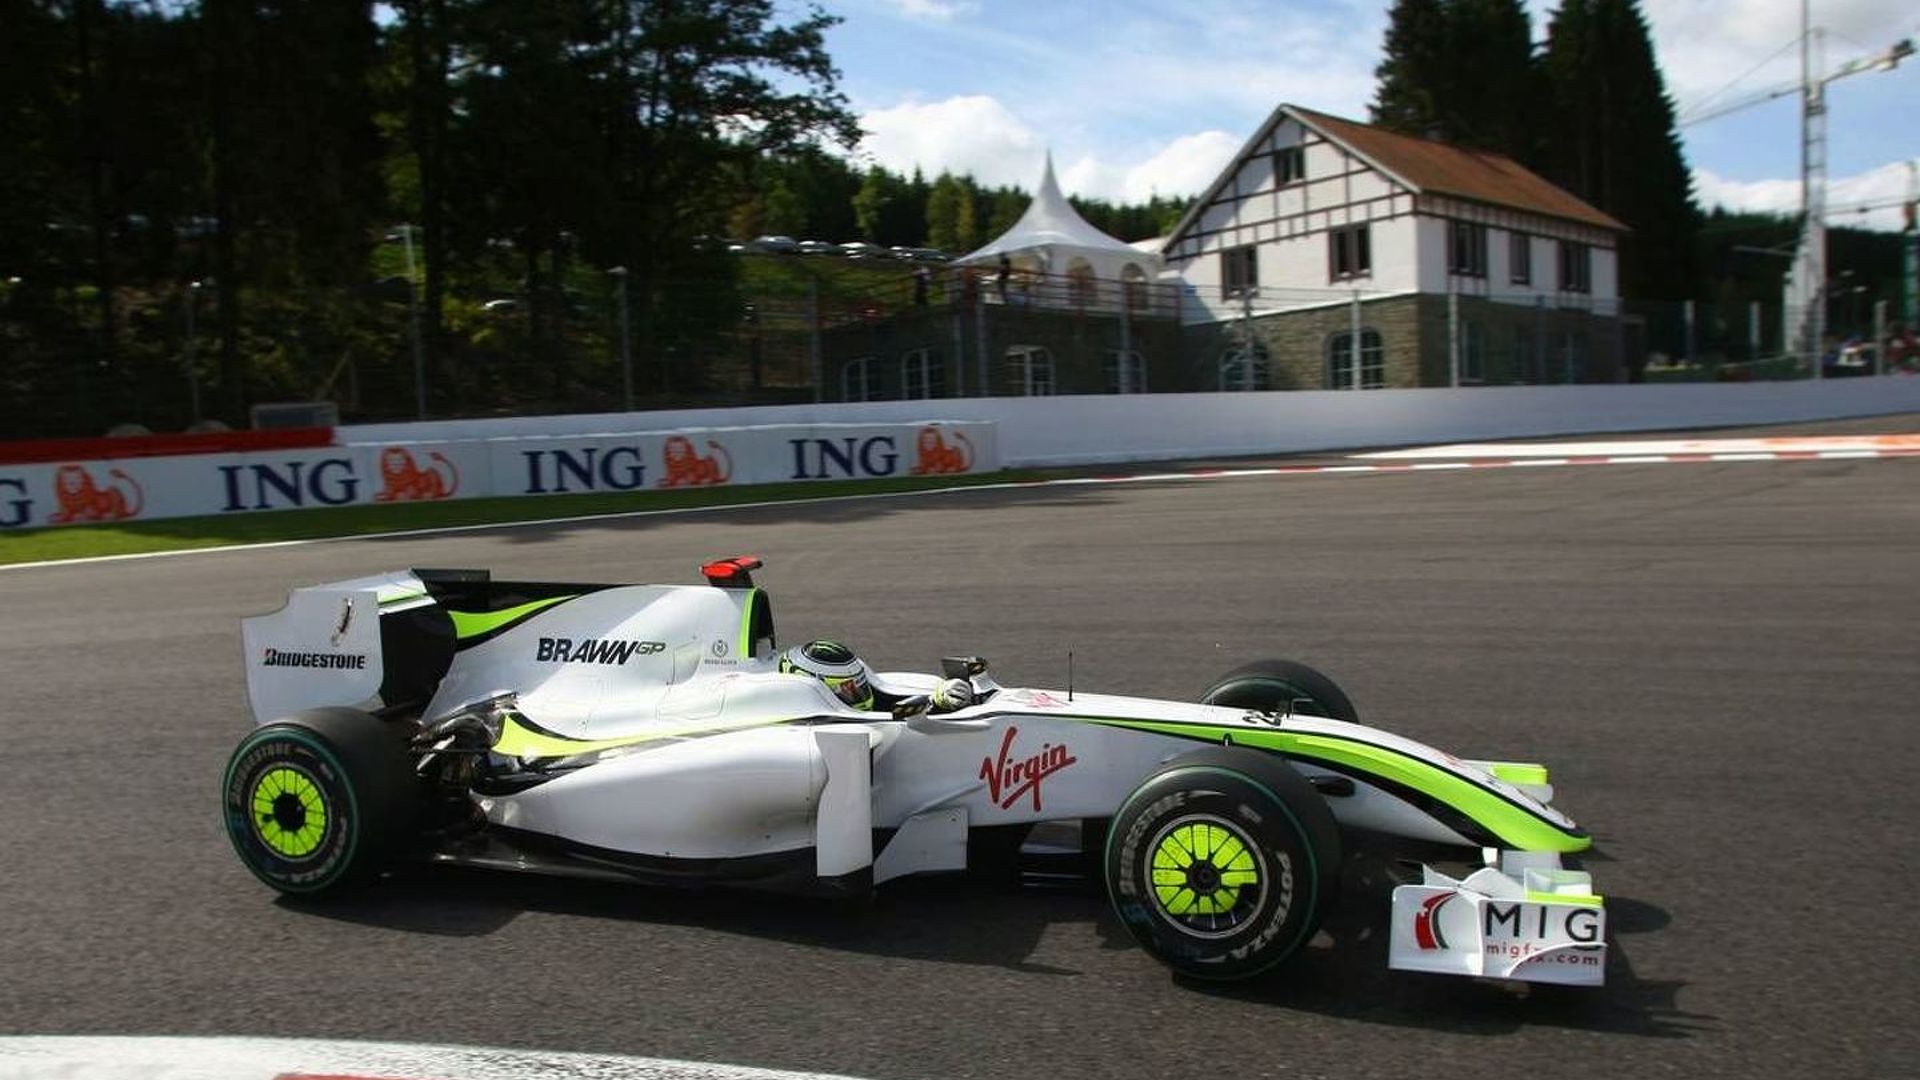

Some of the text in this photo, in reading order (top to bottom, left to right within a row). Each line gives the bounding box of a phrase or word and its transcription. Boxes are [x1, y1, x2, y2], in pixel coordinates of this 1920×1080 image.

[522, 446, 646, 493] ING
[789, 436, 898, 479] ING
[219, 459, 359, 511] ING
[263, 648, 366, 669] BRIDGESTONE
[536, 637, 639, 665] BRAWN
[979, 726, 1077, 812] Virgin
[1485, 902, 1599, 944] MIG
